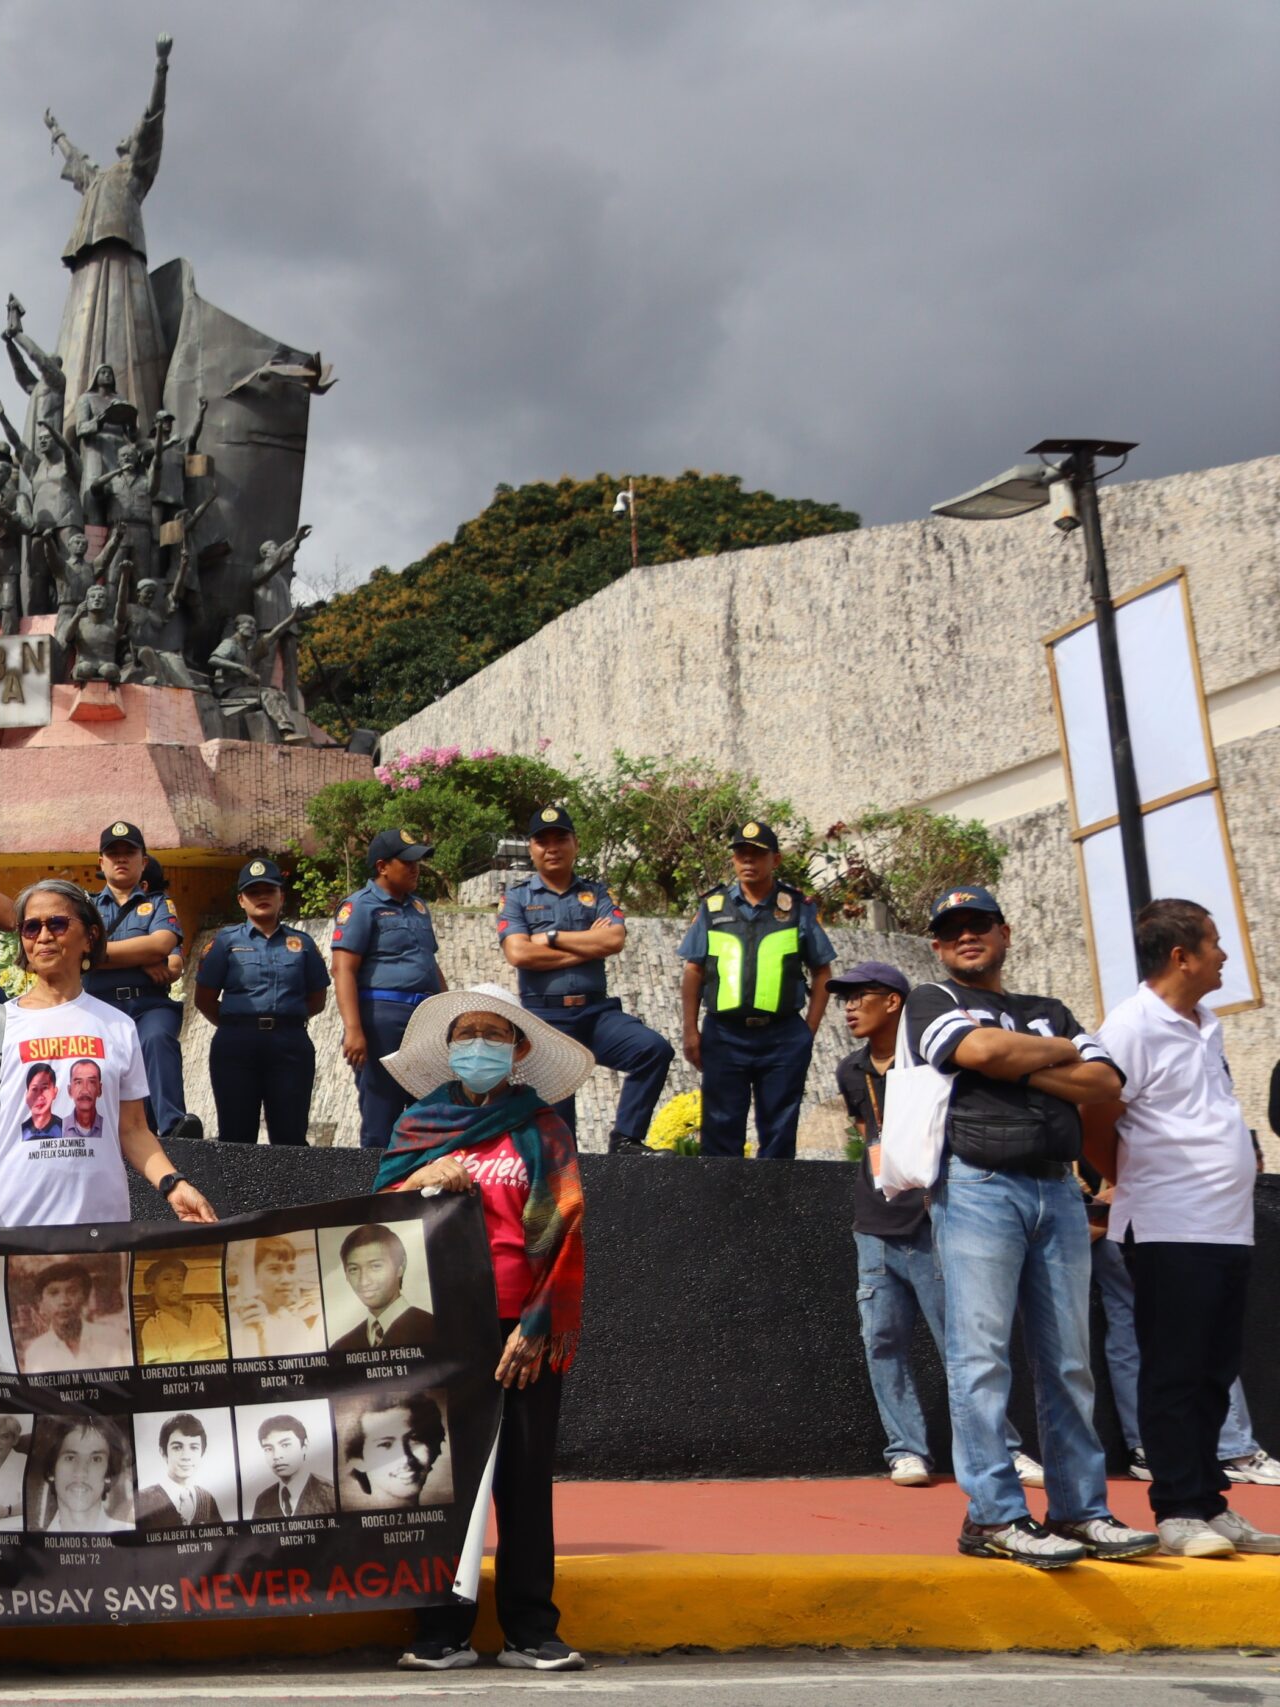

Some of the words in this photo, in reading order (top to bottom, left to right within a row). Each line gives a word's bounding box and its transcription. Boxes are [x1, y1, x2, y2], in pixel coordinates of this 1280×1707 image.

[29, 1035, 97, 1059] SURFACE
[40, 1140, 58, 1150] JAMES
[28, 1151, 40, 1160] AND
[41, 1149, 56, 1159] FELIX
[57, 1148, 87, 1158] SALAVERIA
[346, 1352, 380, 1364] ROGELIO
[381, 1351, 389, 1362] P.
[390, 1346, 424, 1361] PEÑERA,
[141, 1365, 178, 1380] LORENZO
[179, 1365, 188, 1377] C.
[189, 1363, 227, 1376] LANSANG
[233, 1360, 267, 1374] FRANCIS
[268, 1359, 276, 1371] S.
[277, 1356, 329, 1370] SONTILLANO,
[27, 1374, 71, 1387] MARCELINO
[72, 1372, 81, 1384] M.
[83, 1369, 130, 1384] VILLANUEVA
[366, 1366, 393, 1379] BATCH
[162, 1382, 189, 1395] BATCH
[260, 1376, 287, 1388] BATCH
[60, 1389, 84, 1402] BATCH
[361, 1515, 395, 1528] RODELO
[397, 1514, 406, 1526] Z.
[407, 1510, 446, 1524] MANAOG,
[251, 1522, 280, 1535] VICENTE
[280, 1521, 288, 1532] T.
[288, 1519, 326, 1532] GONZALES,
[146, 1532, 162, 1543] LUIS
[163, 1529, 189, 1542] ALBERT
[190, 1529, 197, 1539] N.
[198, 1527, 225, 1539] CAMUS,
[280, 1535, 303, 1547] BATCH
[44, 1537, 80, 1549] ROLANDO
[82, 1537, 90, 1548] S.
[91, 1536, 116, 1549] CADA,
[177, 1543, 199, 1554] BATCH
[60, 1554, 86, 1565] BATCH
[105, 1583, 177, 1612] SAYS
[180, 1568, 312, 1614] NEVER
[326, 1555, 460, 1602] AGAIN
